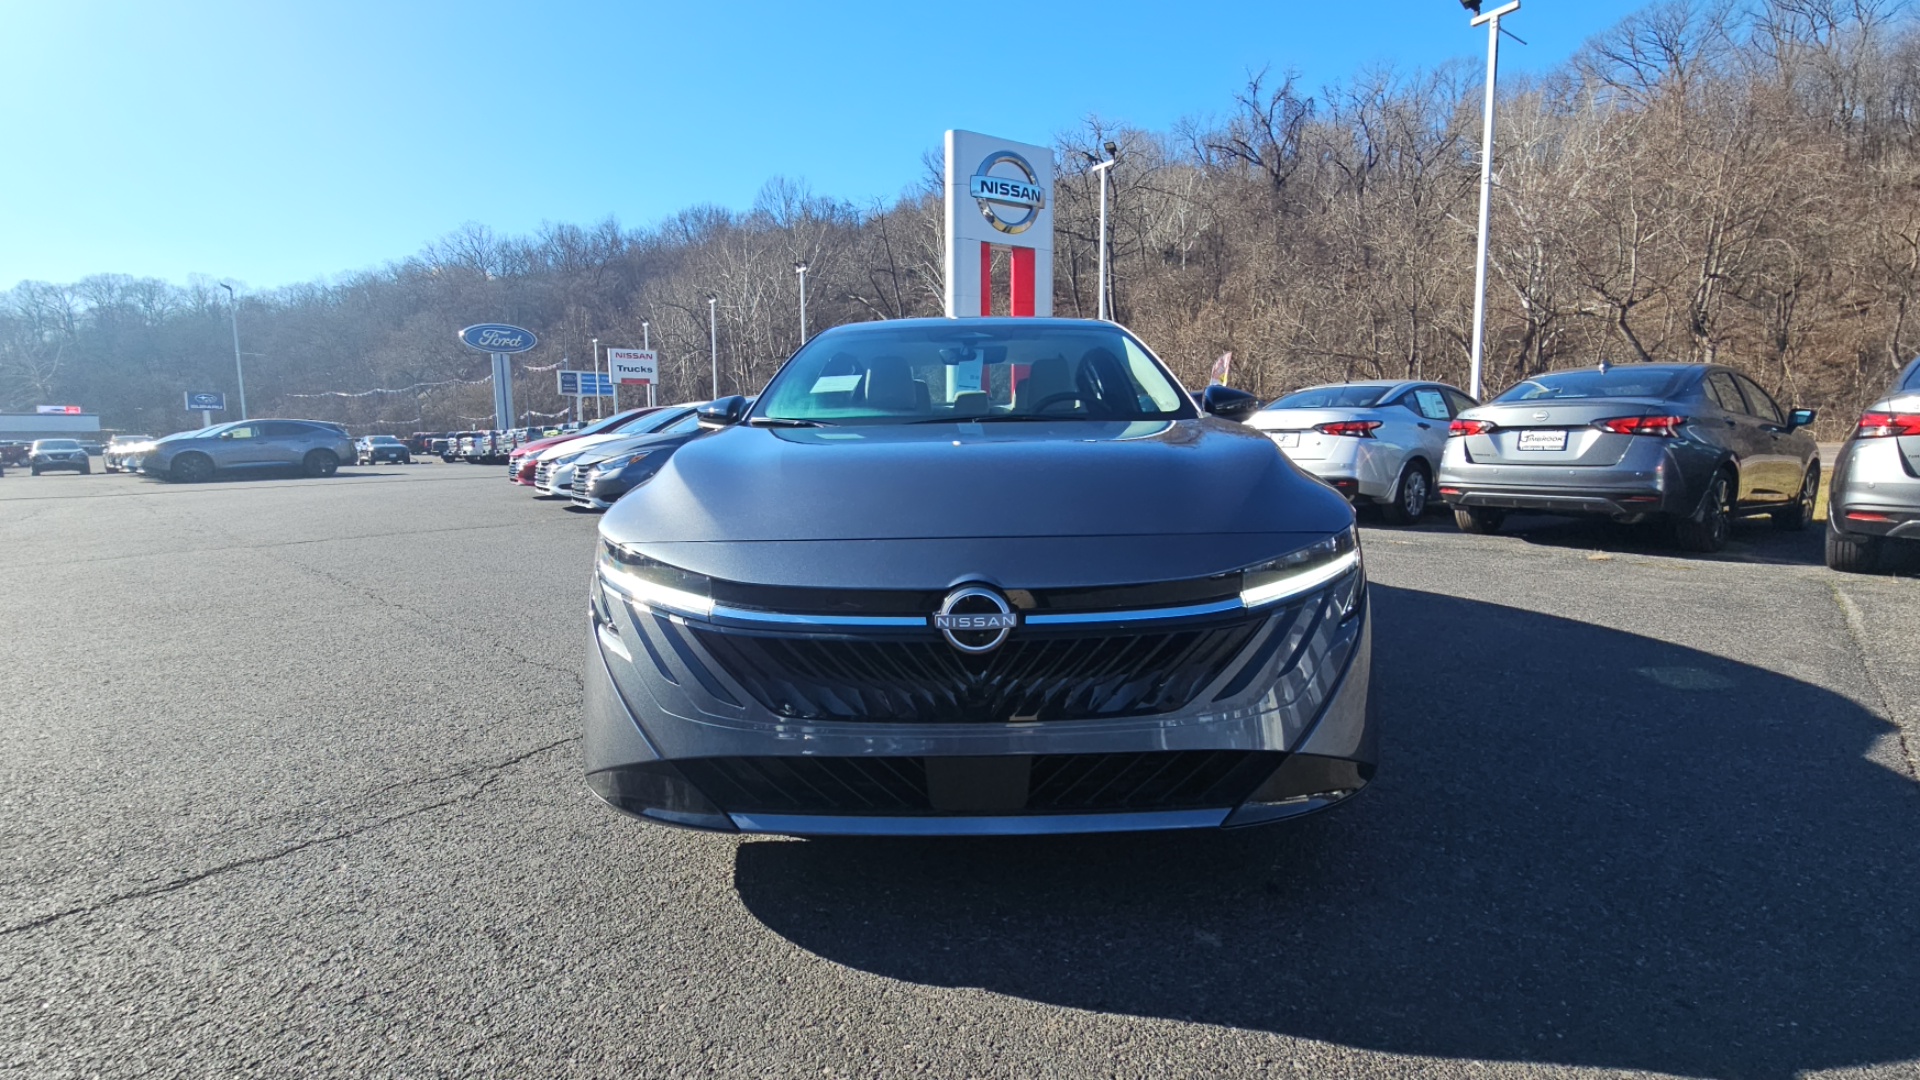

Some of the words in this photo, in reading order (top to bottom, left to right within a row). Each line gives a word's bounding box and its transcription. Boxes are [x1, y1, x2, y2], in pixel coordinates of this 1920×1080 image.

[980, 180, 1041, 202] NISSAN
[478, 329, 523, 348] Ford
[615, 352, 653, 360] NISSAN
[616, 364, 653, 374] Trucks
[937, 615, 1015, 628] NISSAN
